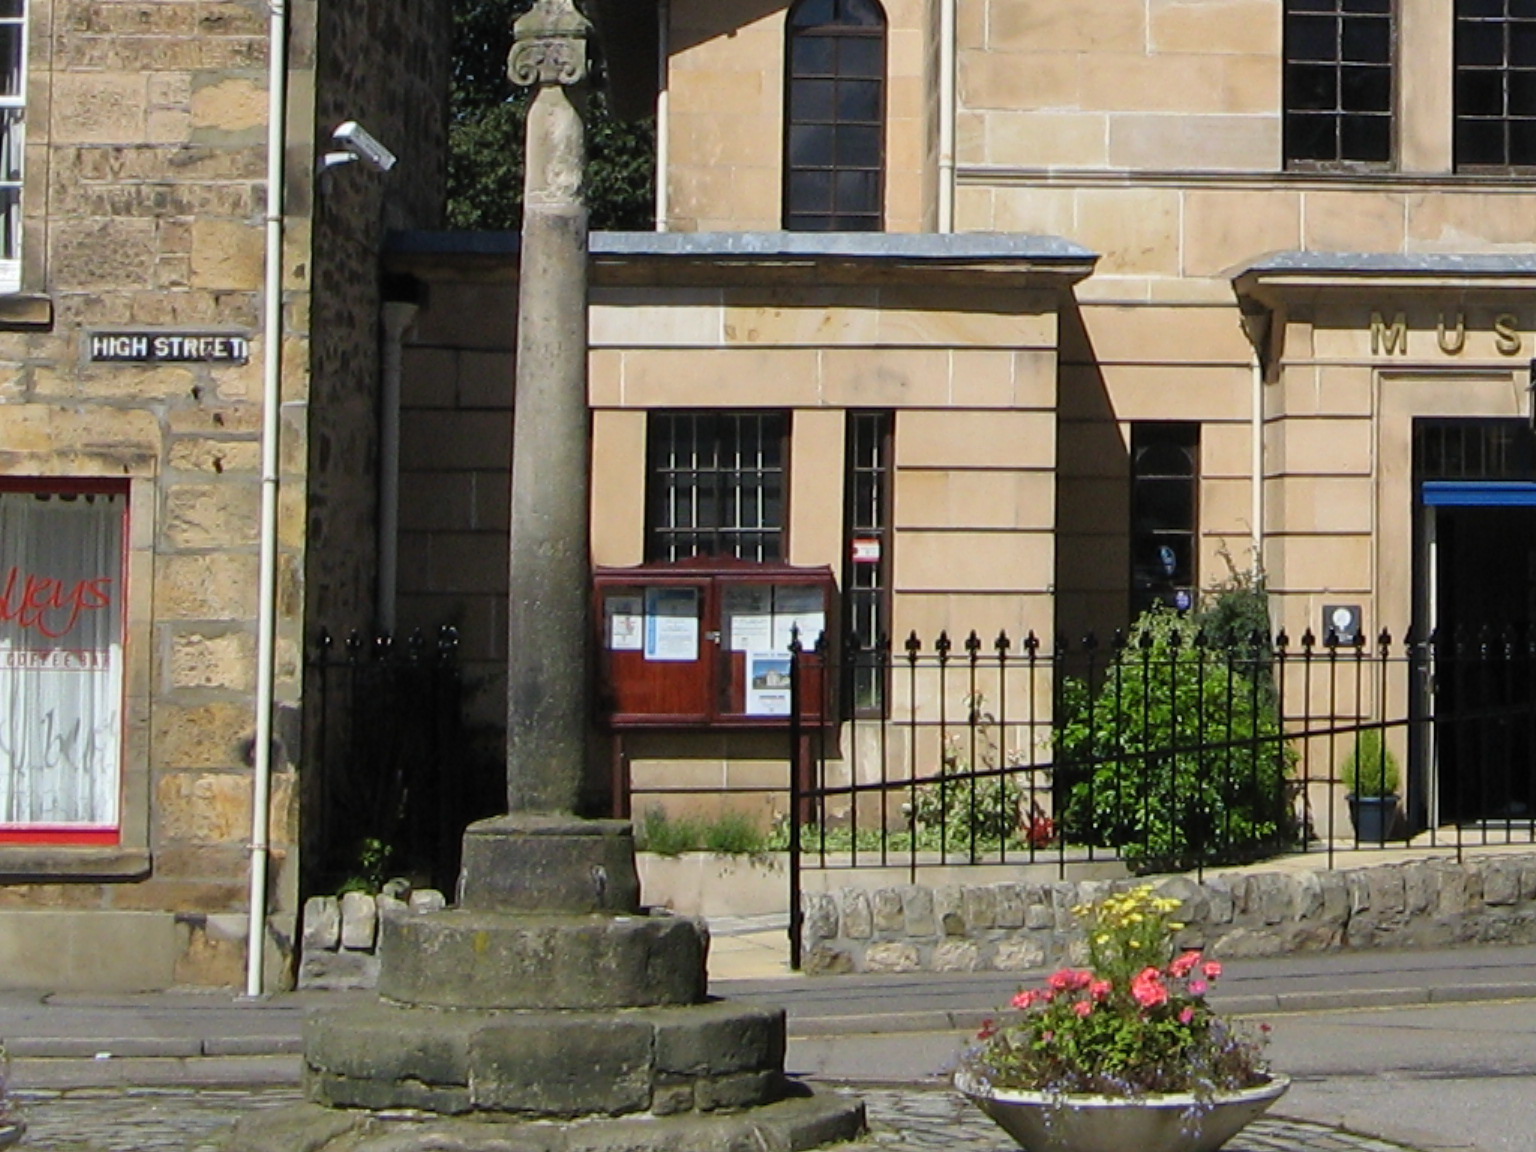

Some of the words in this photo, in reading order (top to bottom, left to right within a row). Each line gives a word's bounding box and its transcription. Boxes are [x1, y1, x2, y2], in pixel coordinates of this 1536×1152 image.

[93, 336, 148, 357] HIGH
[153, 336, 245, 358] STREET
[0, 565, 114, 639] lleys
[6, 651, 73, 667] COFFEE
